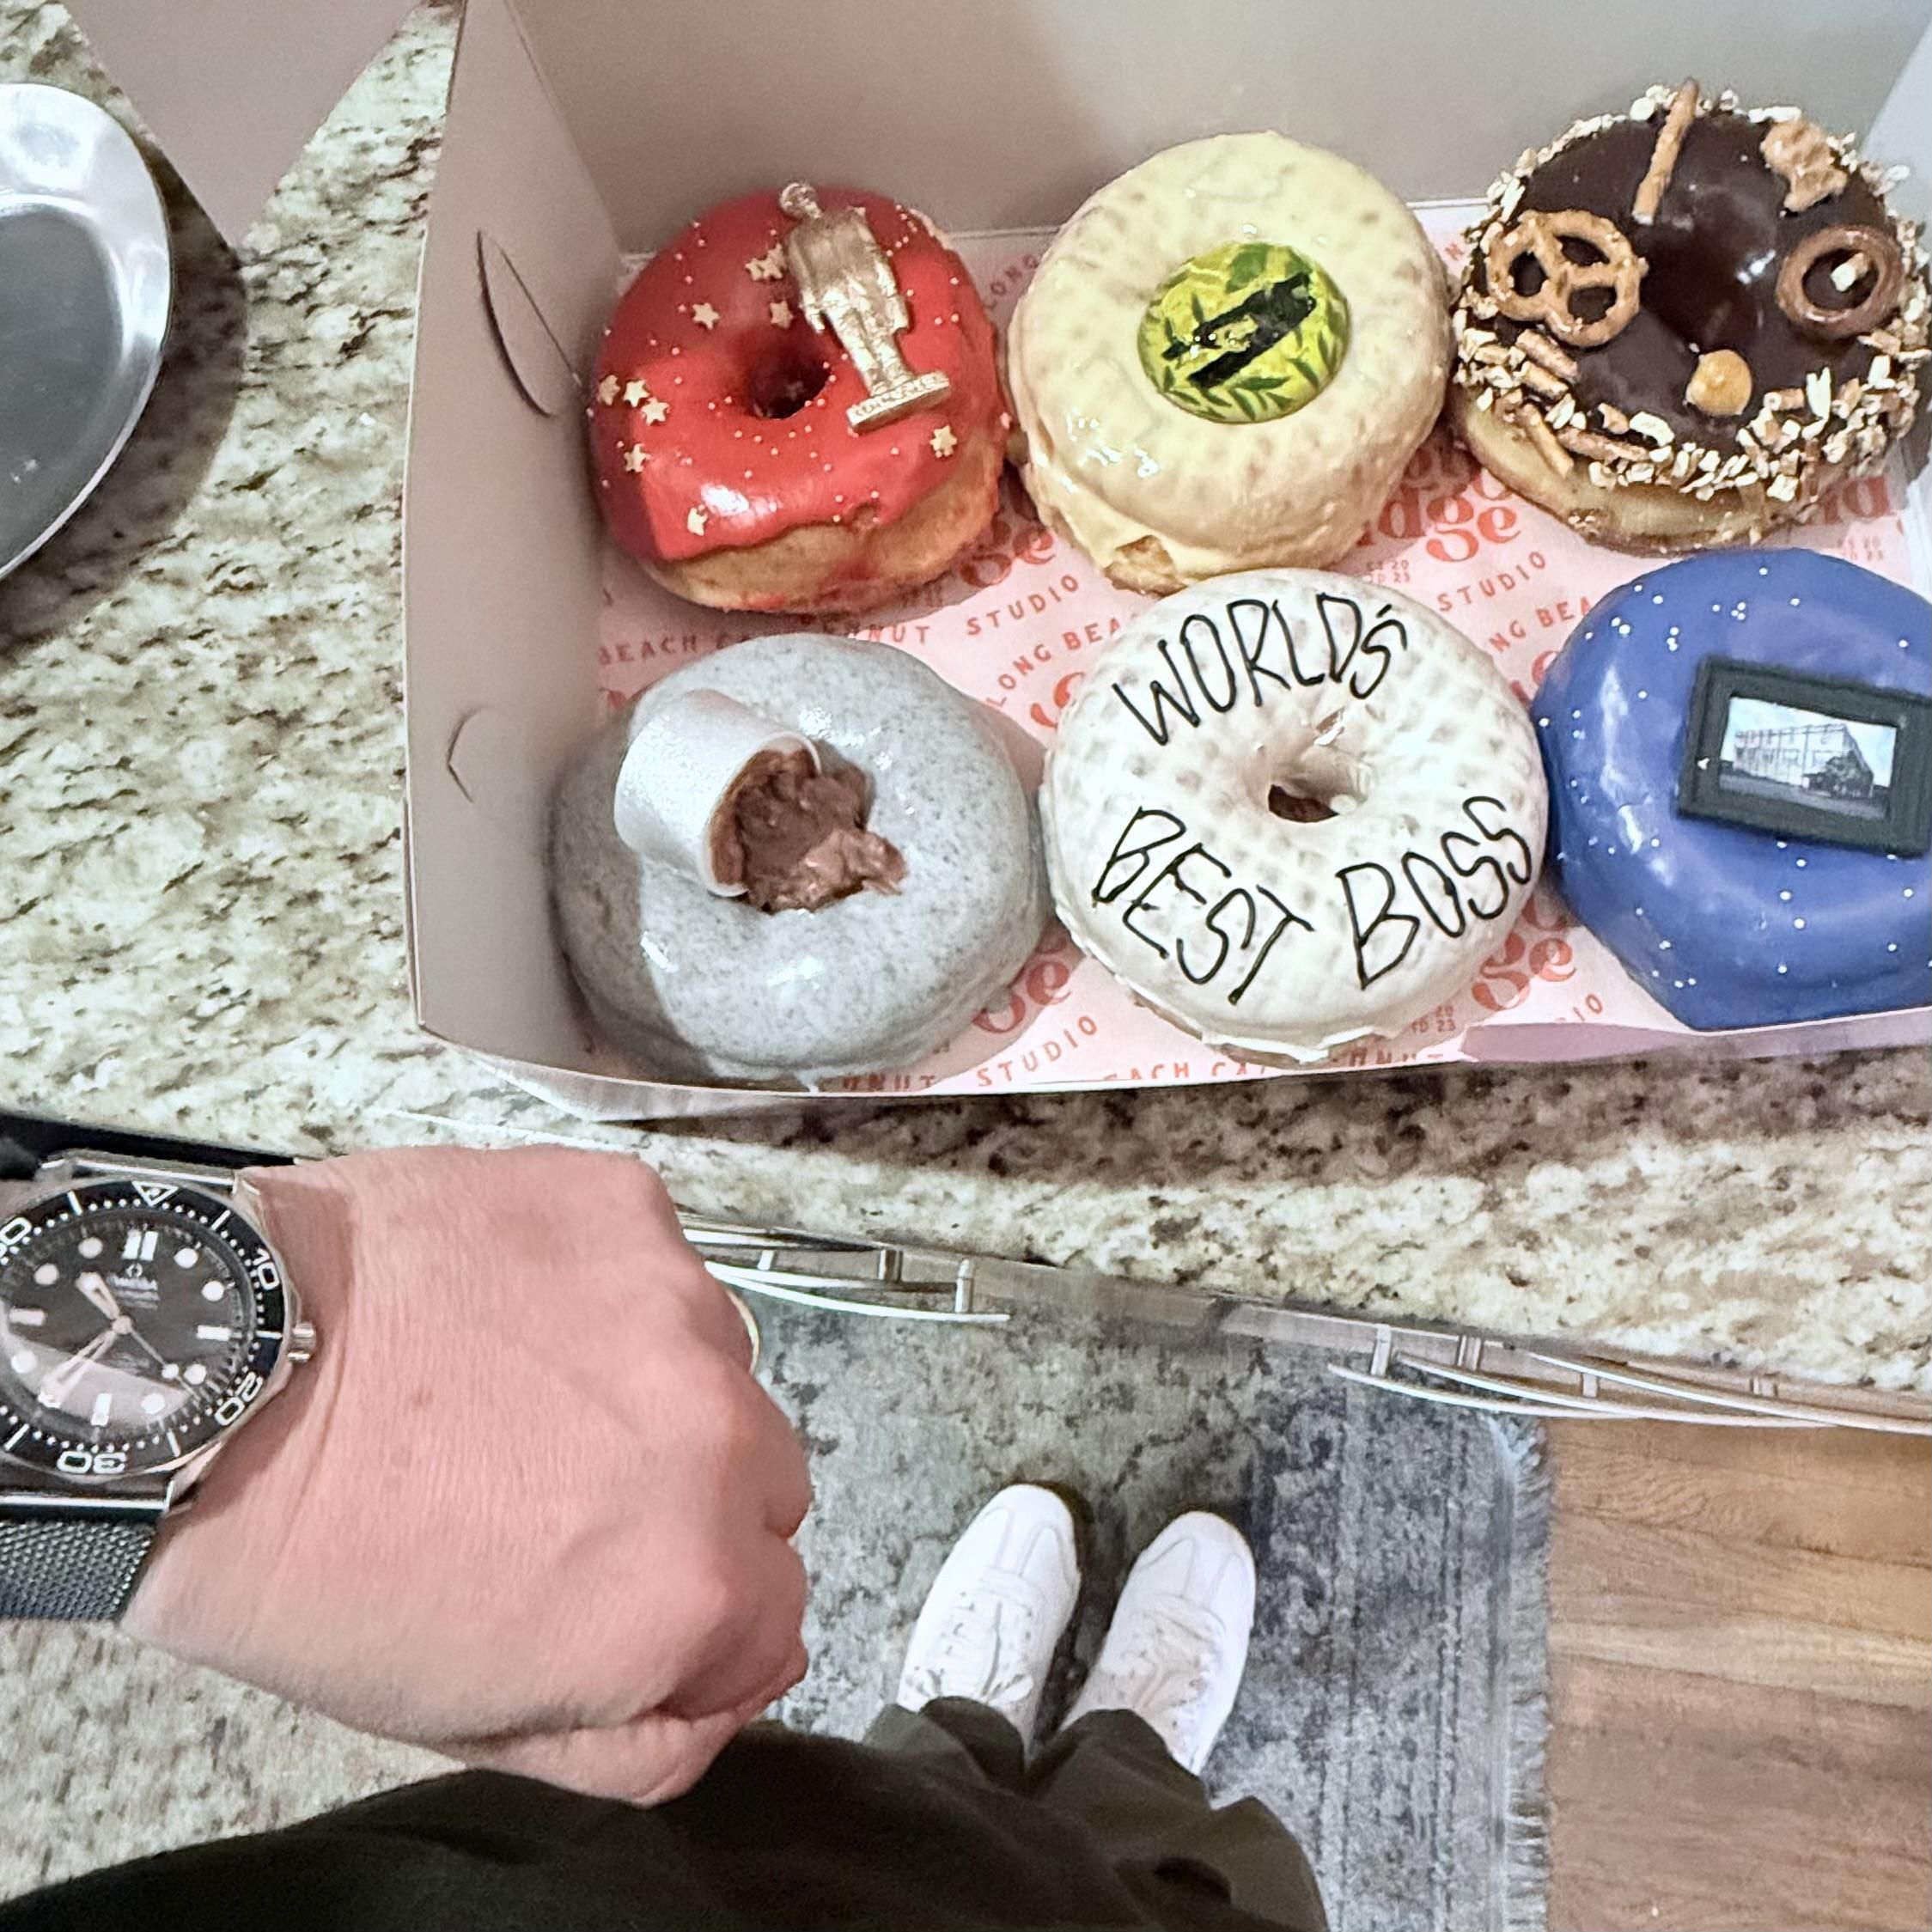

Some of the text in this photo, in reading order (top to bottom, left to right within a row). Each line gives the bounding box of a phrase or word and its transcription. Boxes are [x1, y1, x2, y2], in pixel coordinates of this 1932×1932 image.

[966, 575, 1079, 637] STUDIO
[1437, 551, 1546, 613] STUDIO
[1488, 596, 1592, 653] NG BEA
[986, 643, 1051, 708] LONG
[1063, 616, 1120, 650] BEA
[1091, 795, 1532, 1004] BEST BOSS
[977, 1015, 1098, 1087] STUDIO
[253, 1248, 280, 1289] 10
[215, 1373, 263, 1426] 20
[57, 1451, 127, 1474] 30
